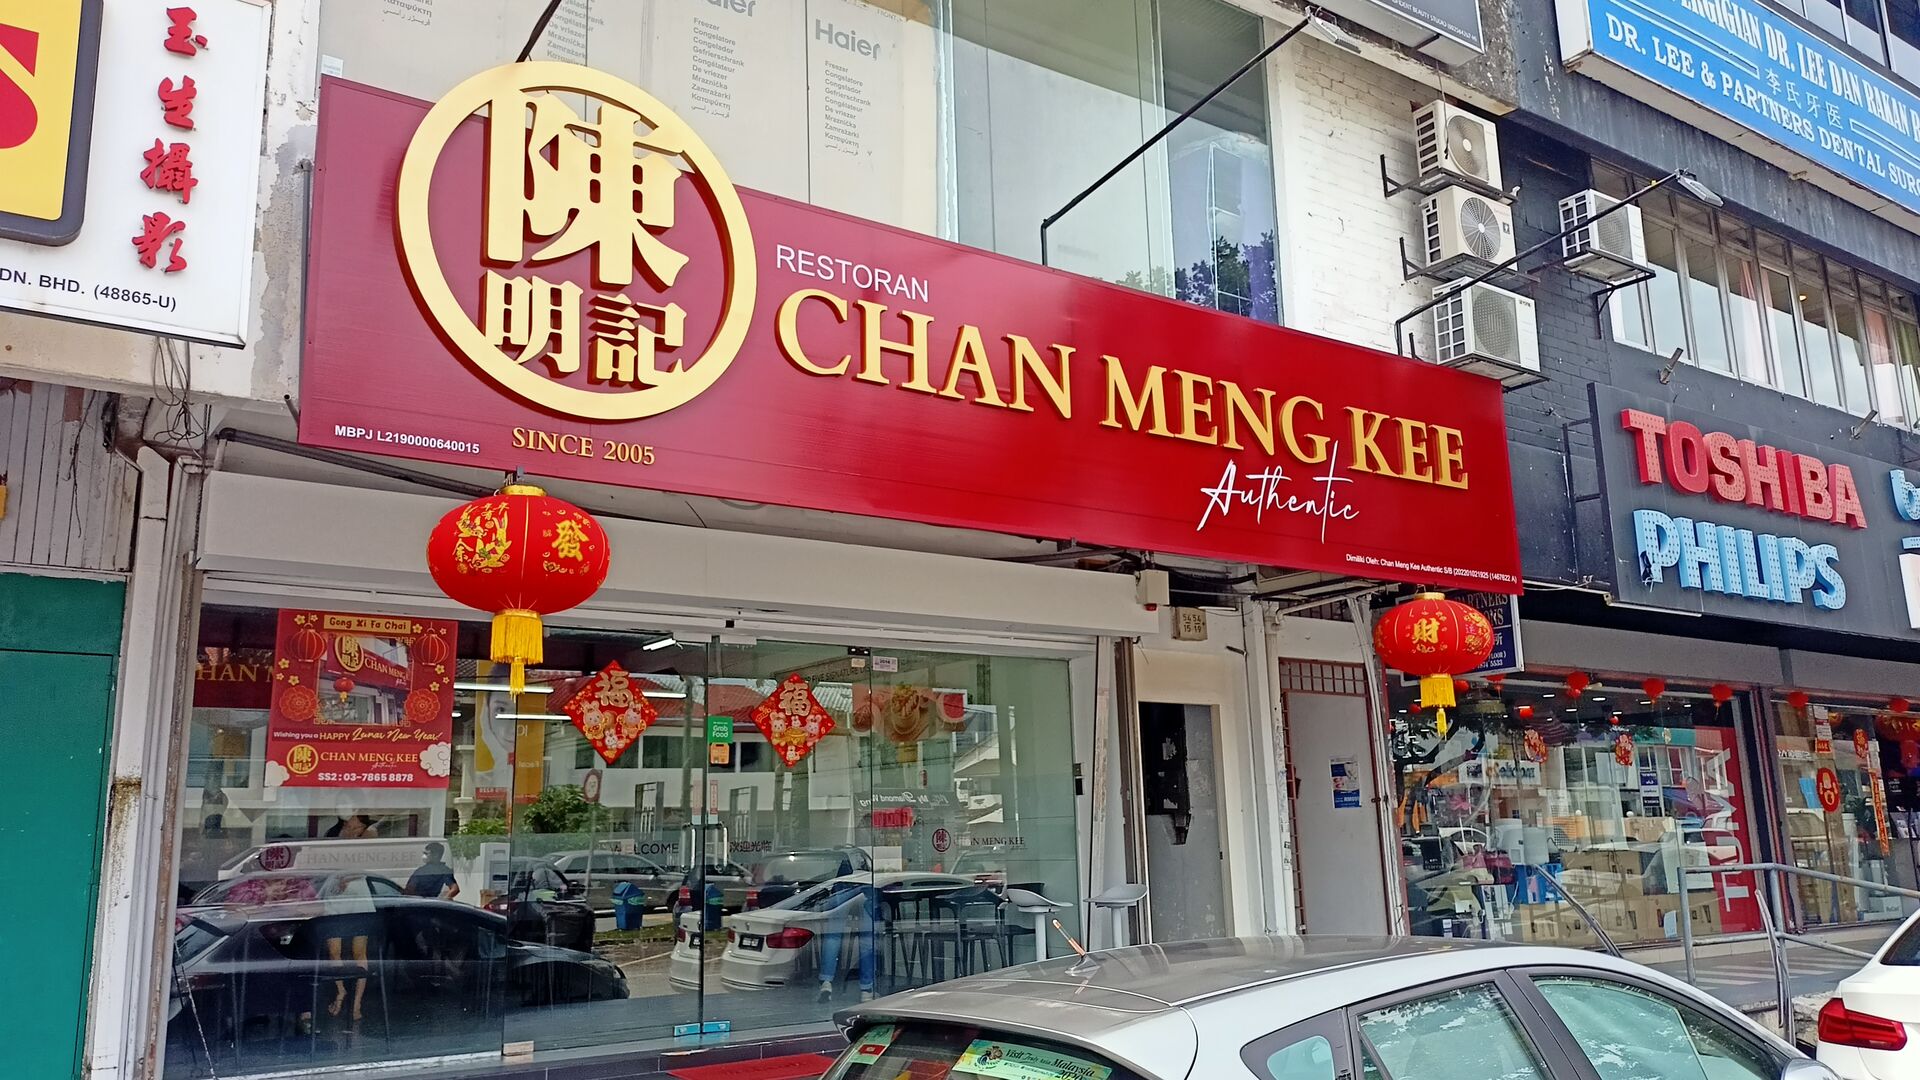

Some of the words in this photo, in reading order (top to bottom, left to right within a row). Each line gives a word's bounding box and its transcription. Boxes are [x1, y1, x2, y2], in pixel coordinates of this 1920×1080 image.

[693, 17, 720, 31] Freezer
[693, 27, 736, 45] Congelatore
[693, 37, 734, 54] Congelador
[815, 18, 881, 60] Haier
[692, 46, 744, 67] Gefrierschrank
[824, 60, 849, 73] Freezer
[704, 69, 727, 80] vriezer
[824, 69, 863, 87] Congelatore
[824, 78, 861, 95] Congelador
[1763, 21, 1796, 73] DR.
[1797, 42, 1827, 90] LEE
[1827, 55, 1864, 108] DAN
[1862, 79, 1910, 138] RAKAN
[824, 87, 871, 106] Gefrierschrank
[1605, 11, 1647, 56] DR.
[1651, 34, 1695, 79] LEE
[1700, 61, 1717, 90] &
[1720, 70, 1815, 142] PARTNERS
[1817, 126, 1886, 177] DENTAL
[1765, 68, 1843, 129] 李氏牙医
[776, 244, 929, 303] RESTORAN
[39, 274, 85, 295] BHD.
[94, 284, 177, 311] (48865-U)
[774, 287, 1076, 419] CHAN
[1099, 354, 1331, 464] MENG
[1343, 406, 1469, 490] KEE
[334, 424, 373, 441] MBPJ
[377, 430, 480, 454] L2190000640015
[511, 426, 594, 458] SINCE
[602, 440, 656, 466] 2005
[1620, 408, 1868, 528] TOSHIBA
[1196, 440, 1360, 544] Authentic
[552, 519, 590, 562] 發
[1365, 556, 1380, 566] Oleh:
[1380, 558, 1394, 568] Chan
[1395, 560, 1409, 571] Meng
[1409, 562, 1420, 571] Kee
[1420, 564, 1443, 573] Authentic
[1633, 509, 1847, 610] PHILIPS
[329, 617, 352, 629] Gong
[356, 618, 367, 628] Xi
[371, 619, 381, 629] Fa
[384, 621, 407, 630] Chai
[1413, 617, 1440, 644] 財
[364, 657, 388, 674] CHAN
[595, 669, 633, 707] 福
[778, 680, 811, 717] 福
[273, 731, 300, 740] Wishing
[320, 732, 350, 740] HAPPY
[352, 727, 385, 741] Lunar
[386, 728, 411, 742] New
[413, 728, 443, 741] Year!
[320, 751, 356, 761] CHAN
[358, 753, 393, 762] MENG
[396, 753, 418, 762] KEE
[318, 773, 337, 781] SS2
[343, 773, 387, 781] 03-7865
[388, 773, 413, 782] 8878
[610, 843, 679, 856] WELCOME
[1005, 1049, 1025, 1060] Visit
[1050, 1058, 1095, 1077] Malaysia
